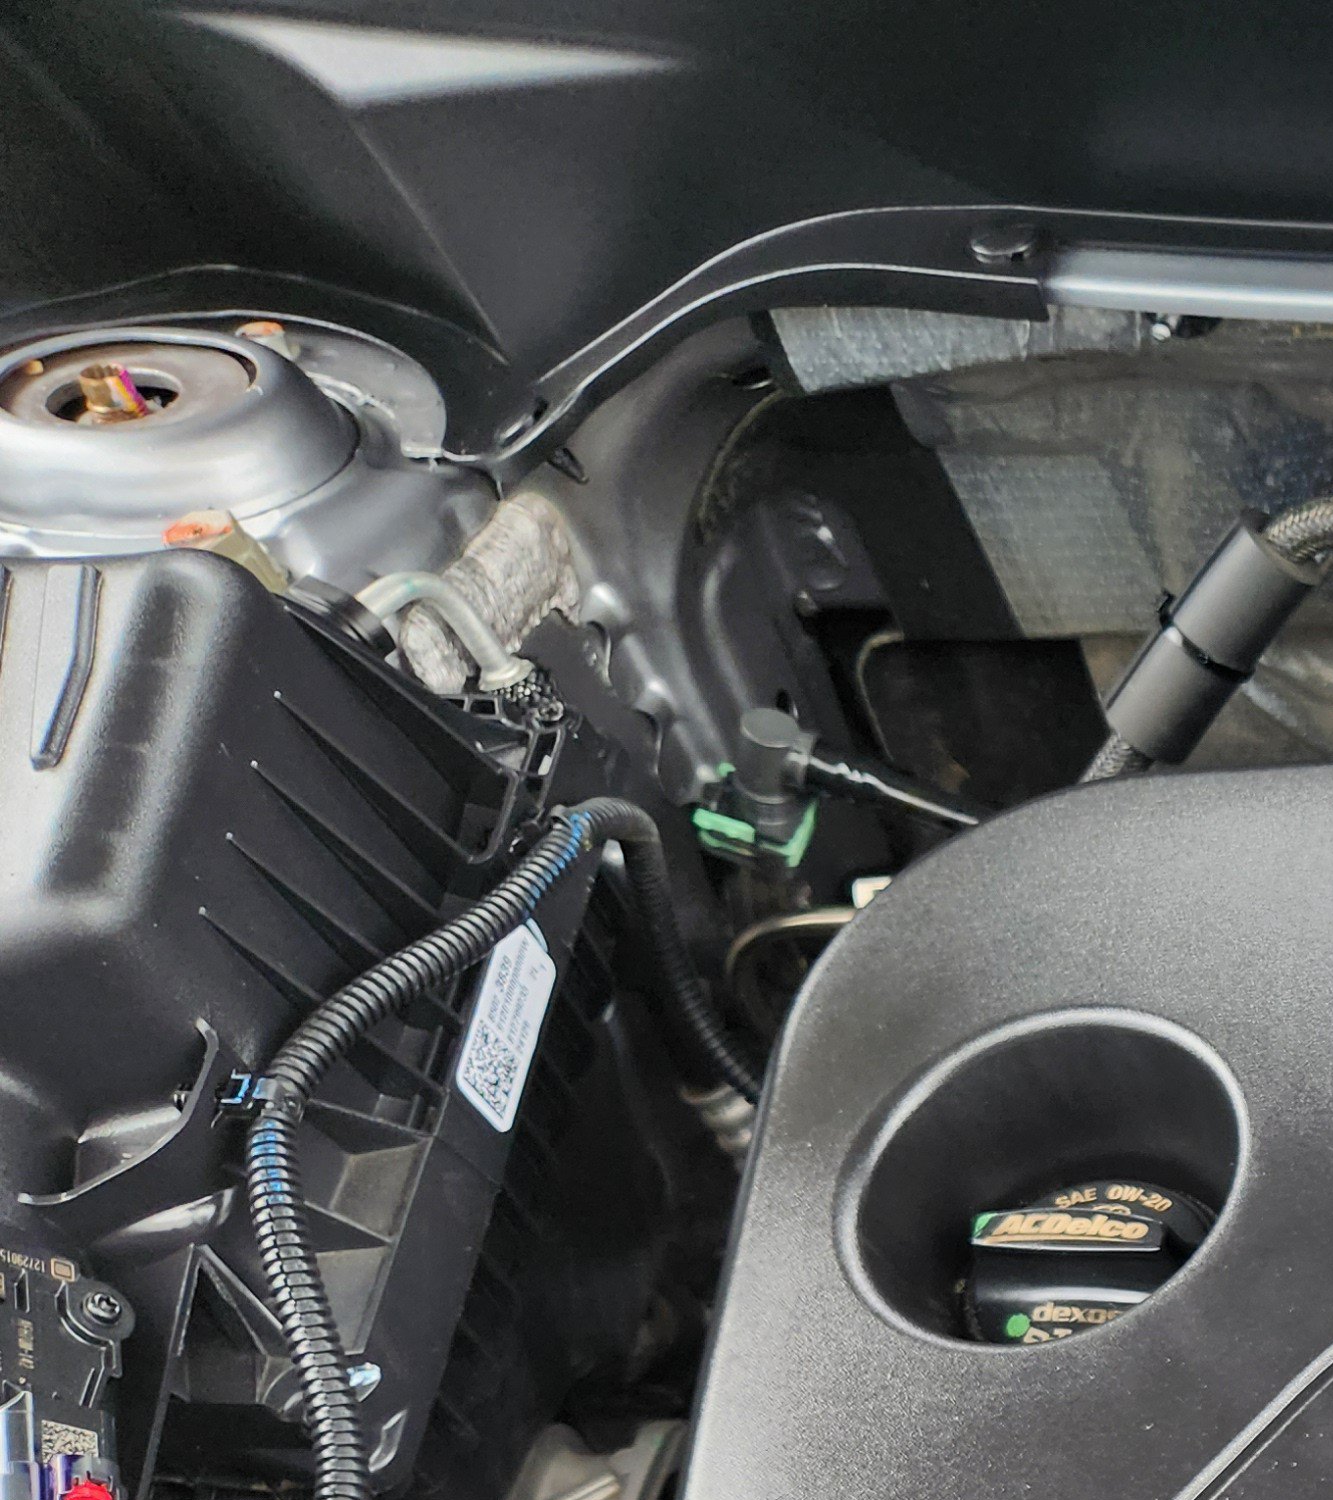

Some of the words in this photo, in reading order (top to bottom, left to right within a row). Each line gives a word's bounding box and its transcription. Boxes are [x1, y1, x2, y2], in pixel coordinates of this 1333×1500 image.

[1055, 1187, 1098, 1209] SAE
[1105, 1184, 1173, 1213] 0W-20
[991, 1212, 1150, 1240] ACDelco
